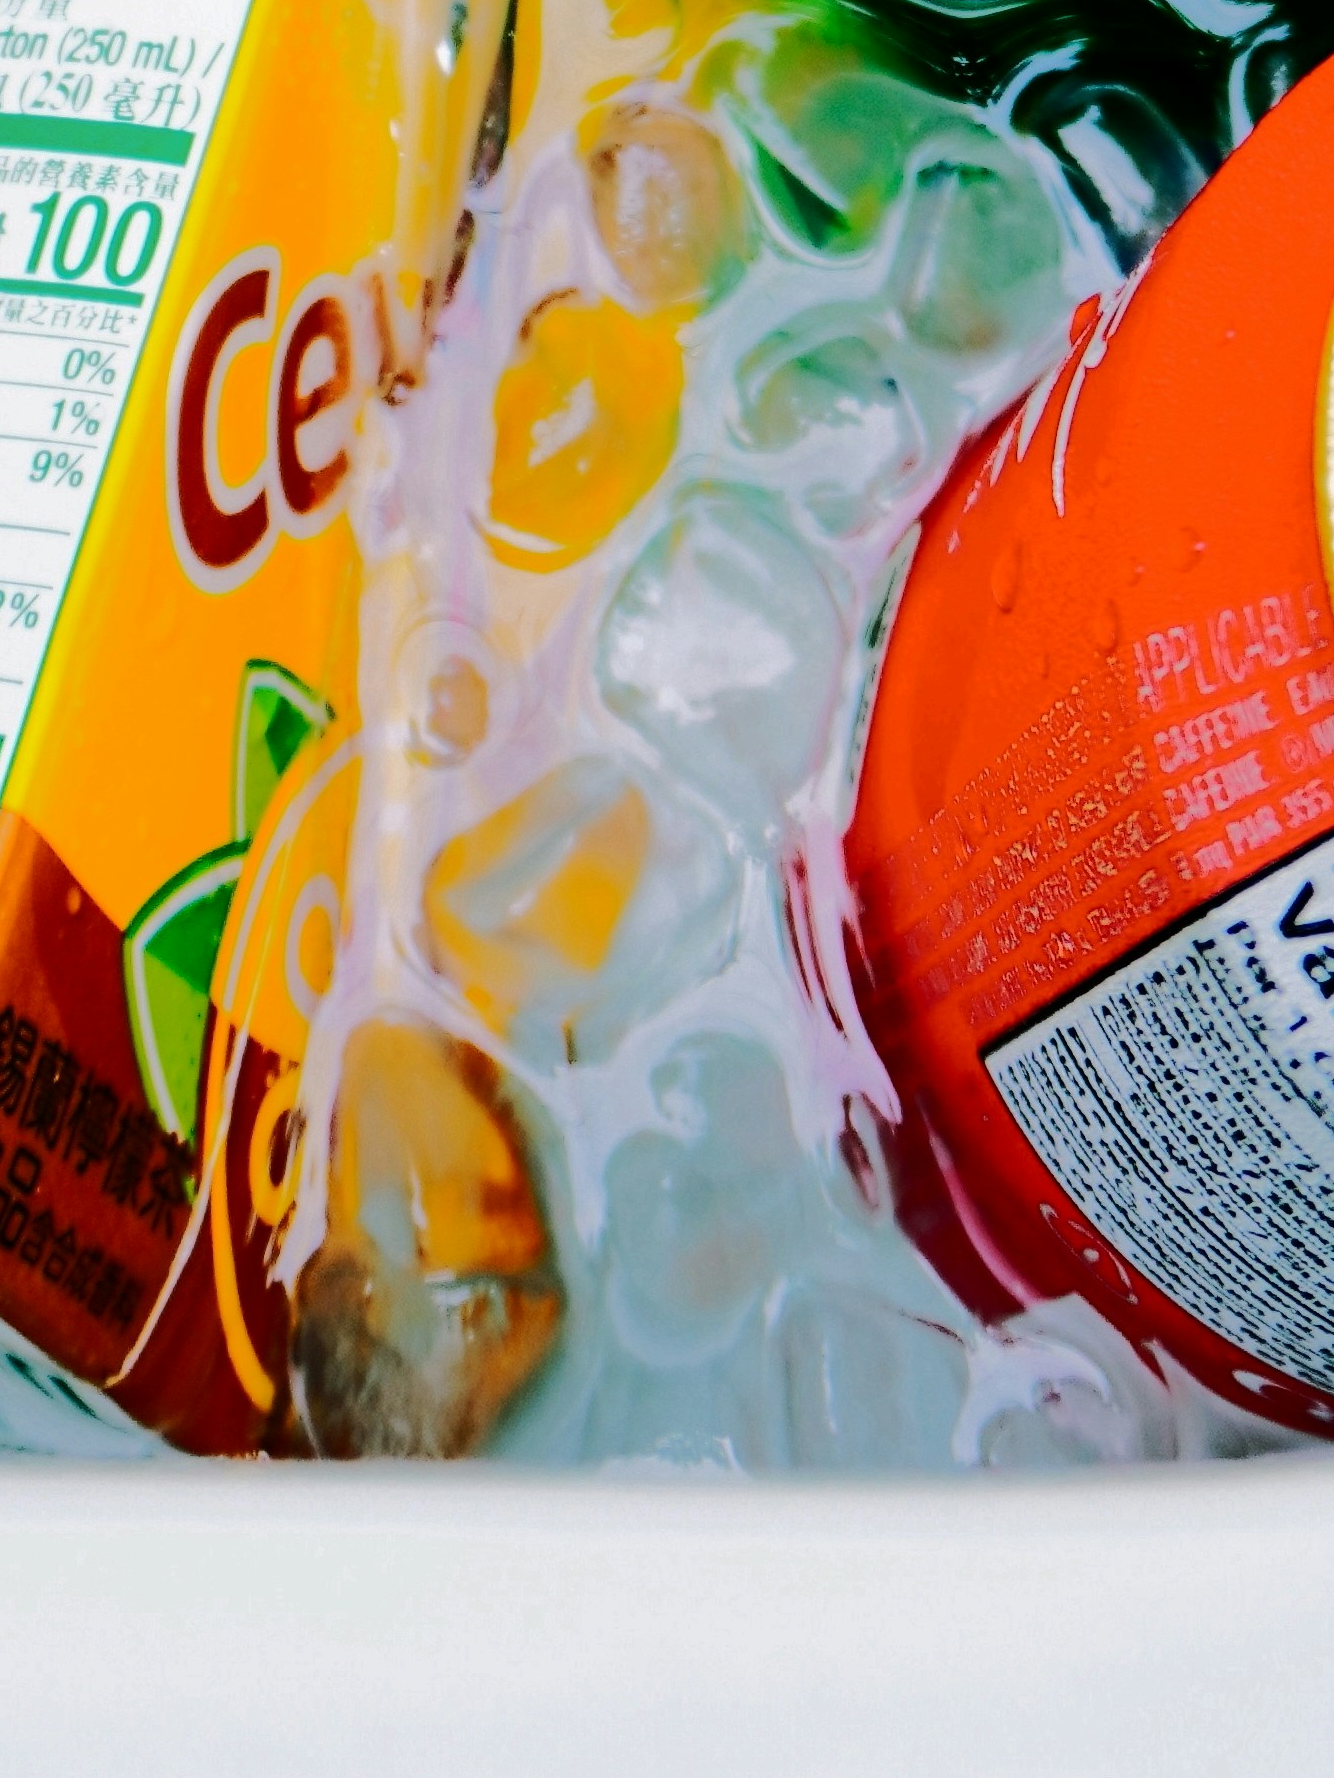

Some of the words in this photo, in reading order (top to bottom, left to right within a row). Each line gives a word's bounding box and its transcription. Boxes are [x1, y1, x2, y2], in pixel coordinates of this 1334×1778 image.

[55, 26, 127, 67] (250
[131, 34, 197, 78] mL)
[16, 190, 164, 287] 100
[60, 346, 117, 386] 0%
[49, 397, 101, 437] 1%
[27, 448, 85, 489] 9%
